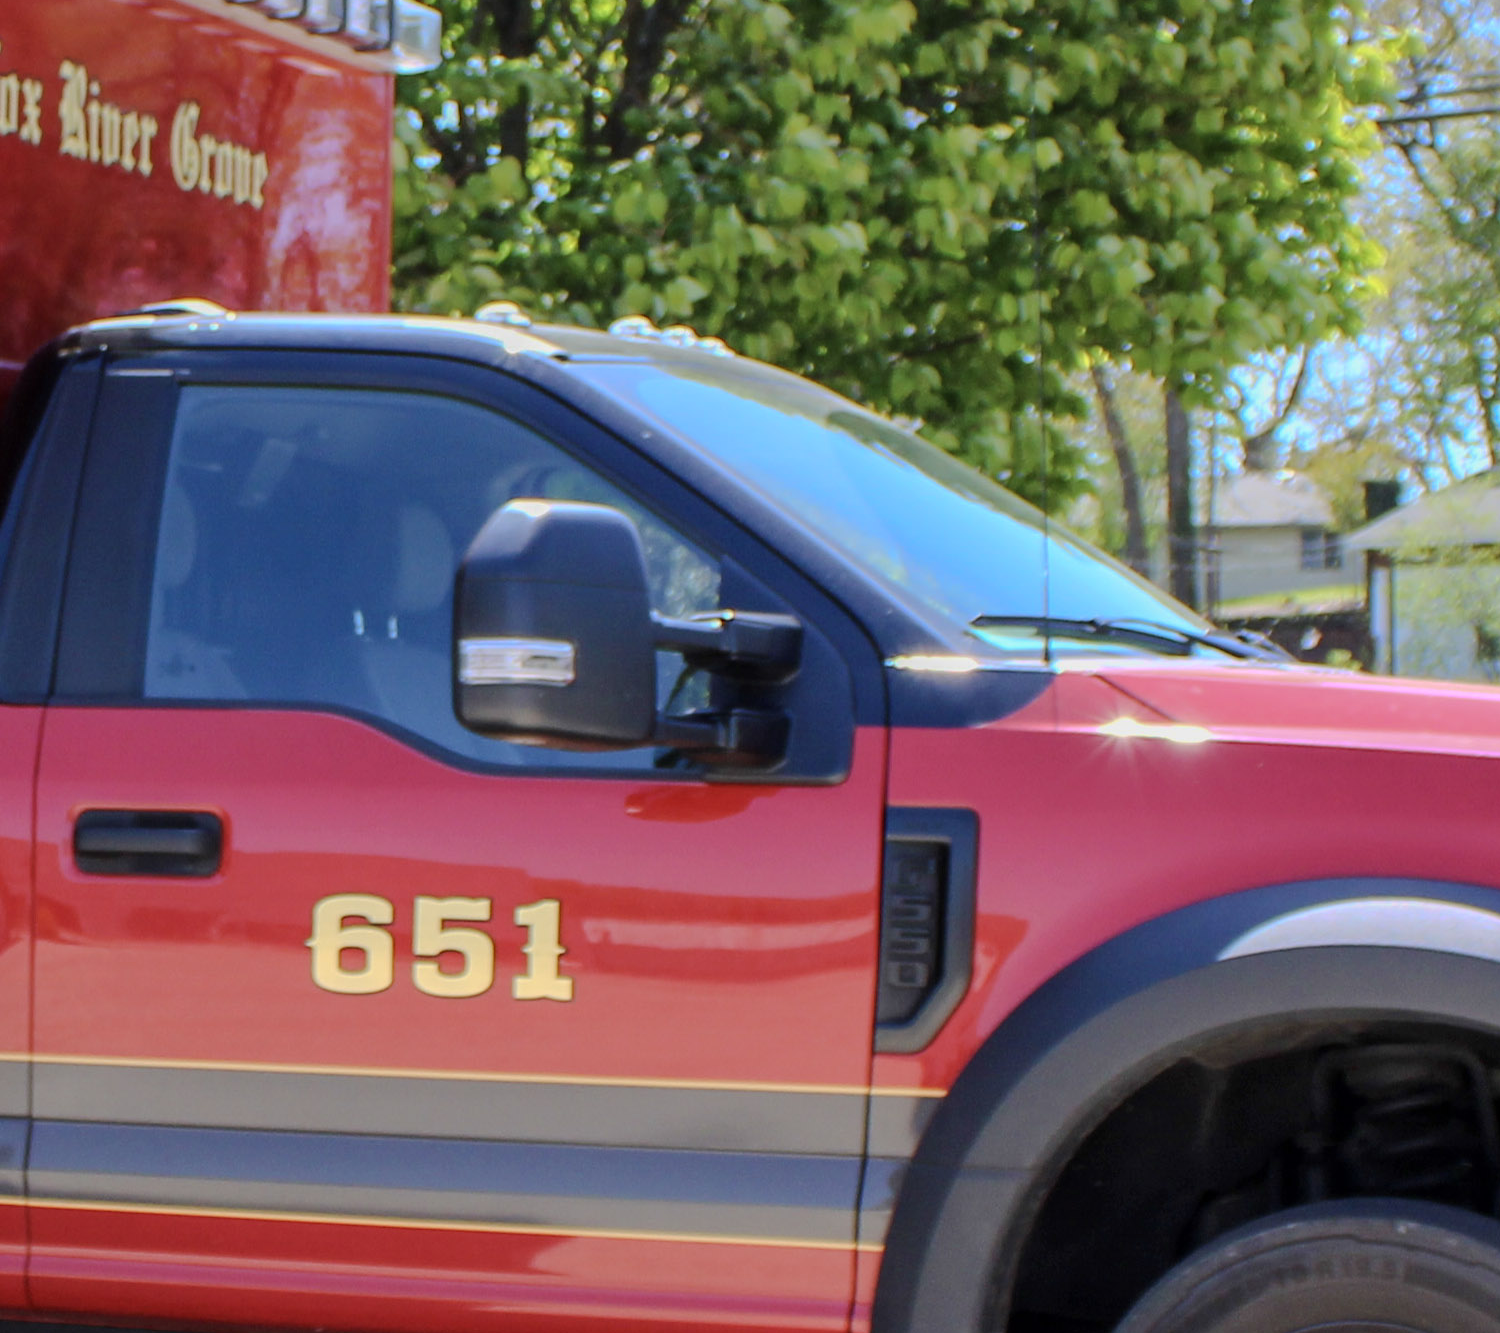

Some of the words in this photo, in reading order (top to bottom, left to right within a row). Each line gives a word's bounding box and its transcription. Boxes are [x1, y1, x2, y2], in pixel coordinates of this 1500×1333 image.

[57, 59, 160, 174] River
[171, 101, 269, 209] Grove
[304, 892, 575, 1004] 651
